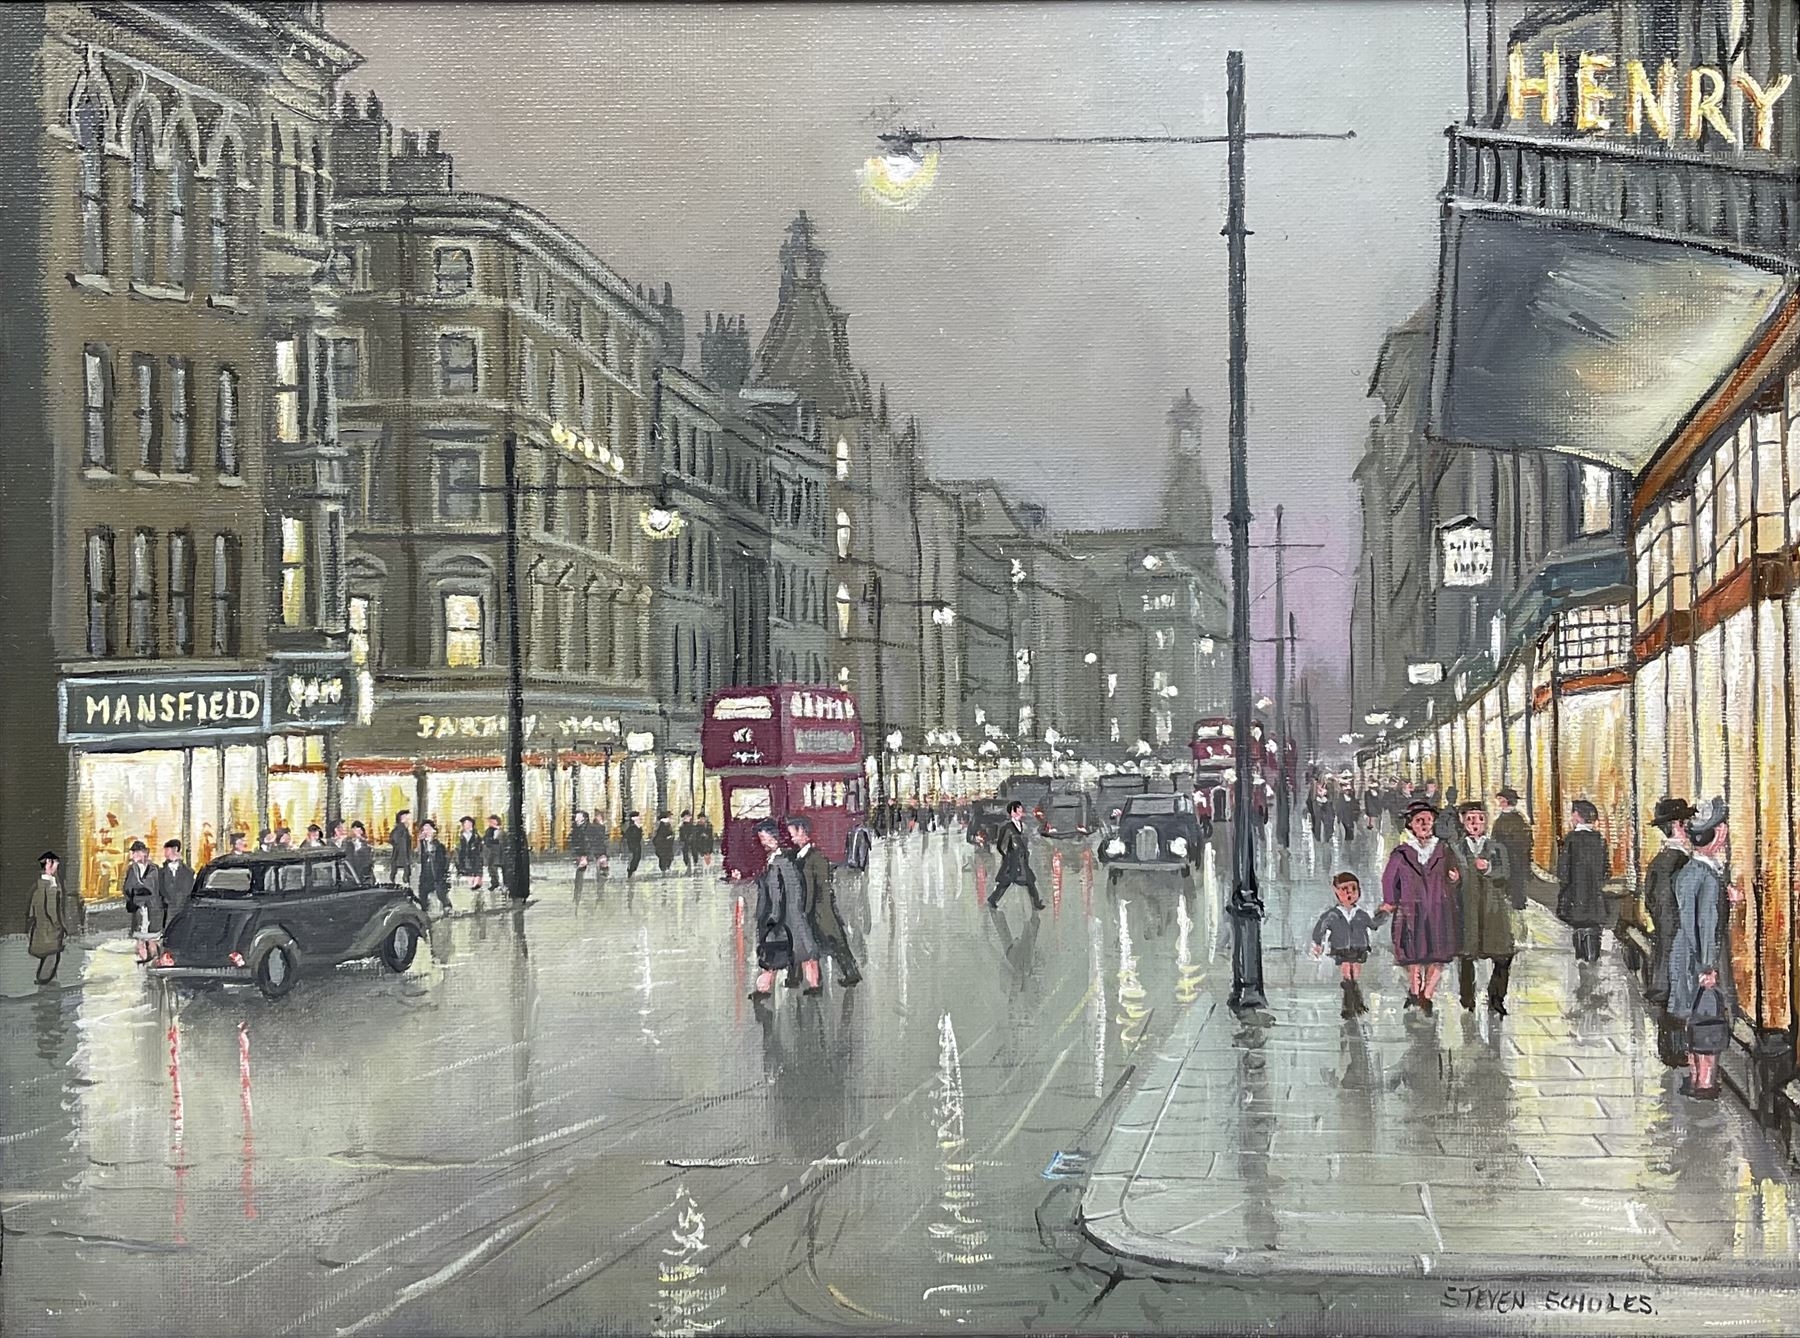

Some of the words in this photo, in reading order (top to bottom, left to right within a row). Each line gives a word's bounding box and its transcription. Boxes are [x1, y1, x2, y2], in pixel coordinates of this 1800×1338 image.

[1507, 43, 1793, 151] HENRY
[86, 688, 260, 725] MANSFIELD
[1440, 1285, 1525, 1313] STEVEN
